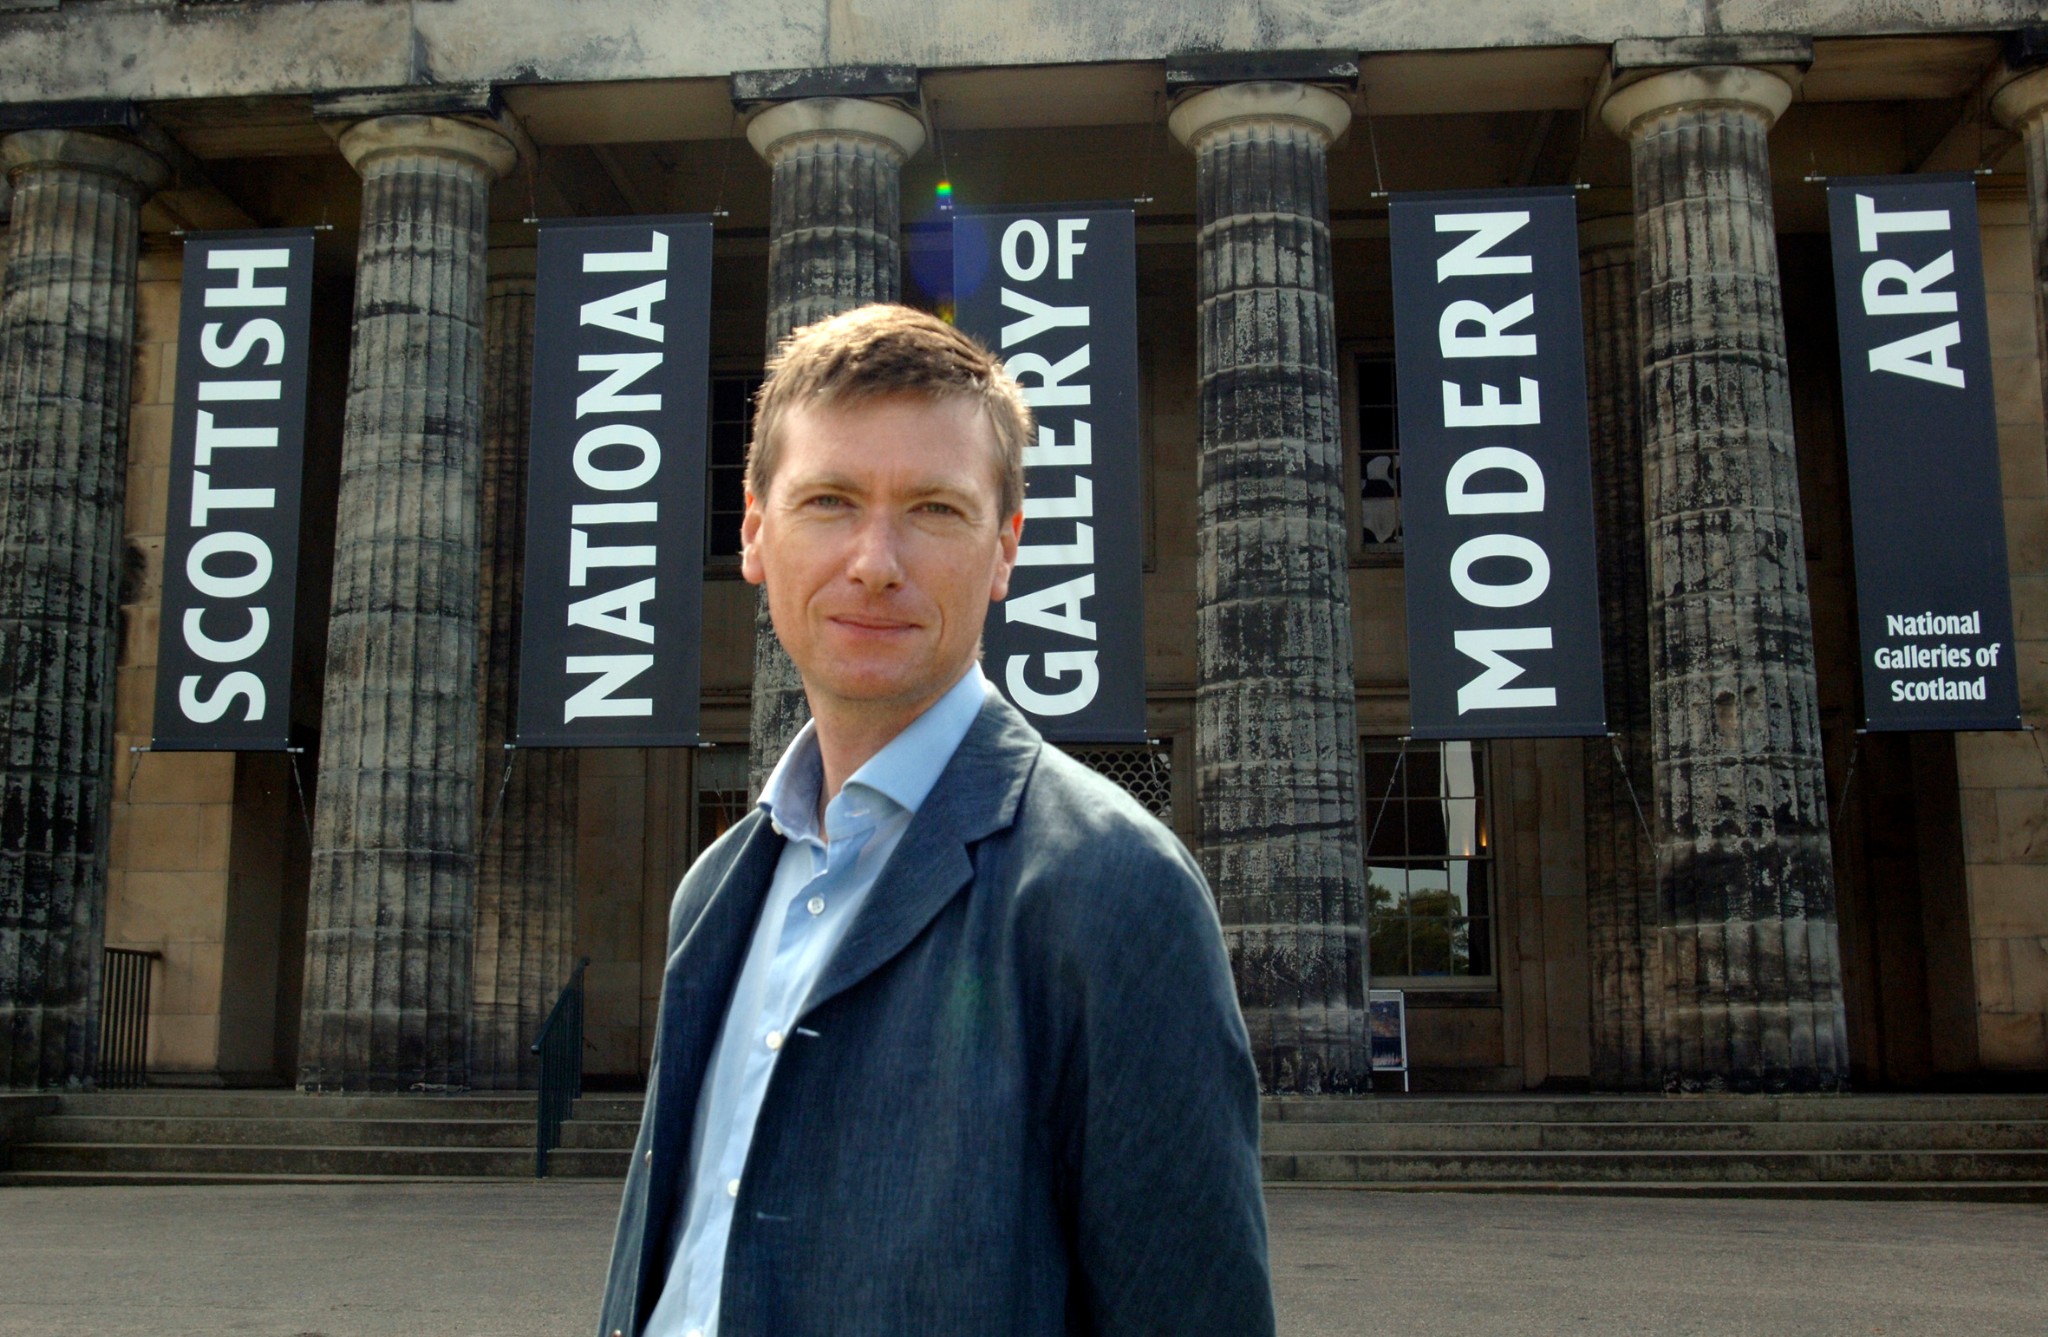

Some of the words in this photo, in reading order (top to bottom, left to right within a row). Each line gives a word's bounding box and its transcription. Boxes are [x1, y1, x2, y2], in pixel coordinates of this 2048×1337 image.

[1000, 218, 1090, 282] OF
[1855, 194, 1965, 389] ART
[179, 248, 290, 723] SCOTTISH
[564, 230, 669, 724] NATIONAL
[1001, 287, 1100, 716] GALLERY
[1434, 211, 1557, 716] MODERN
[1873, 643, 1972, 669] Galleries
[1975, 642, 2001, 668] of
[1886, 610, 1981, 636] National
[1890, 676, 1987, 702] Scotland
